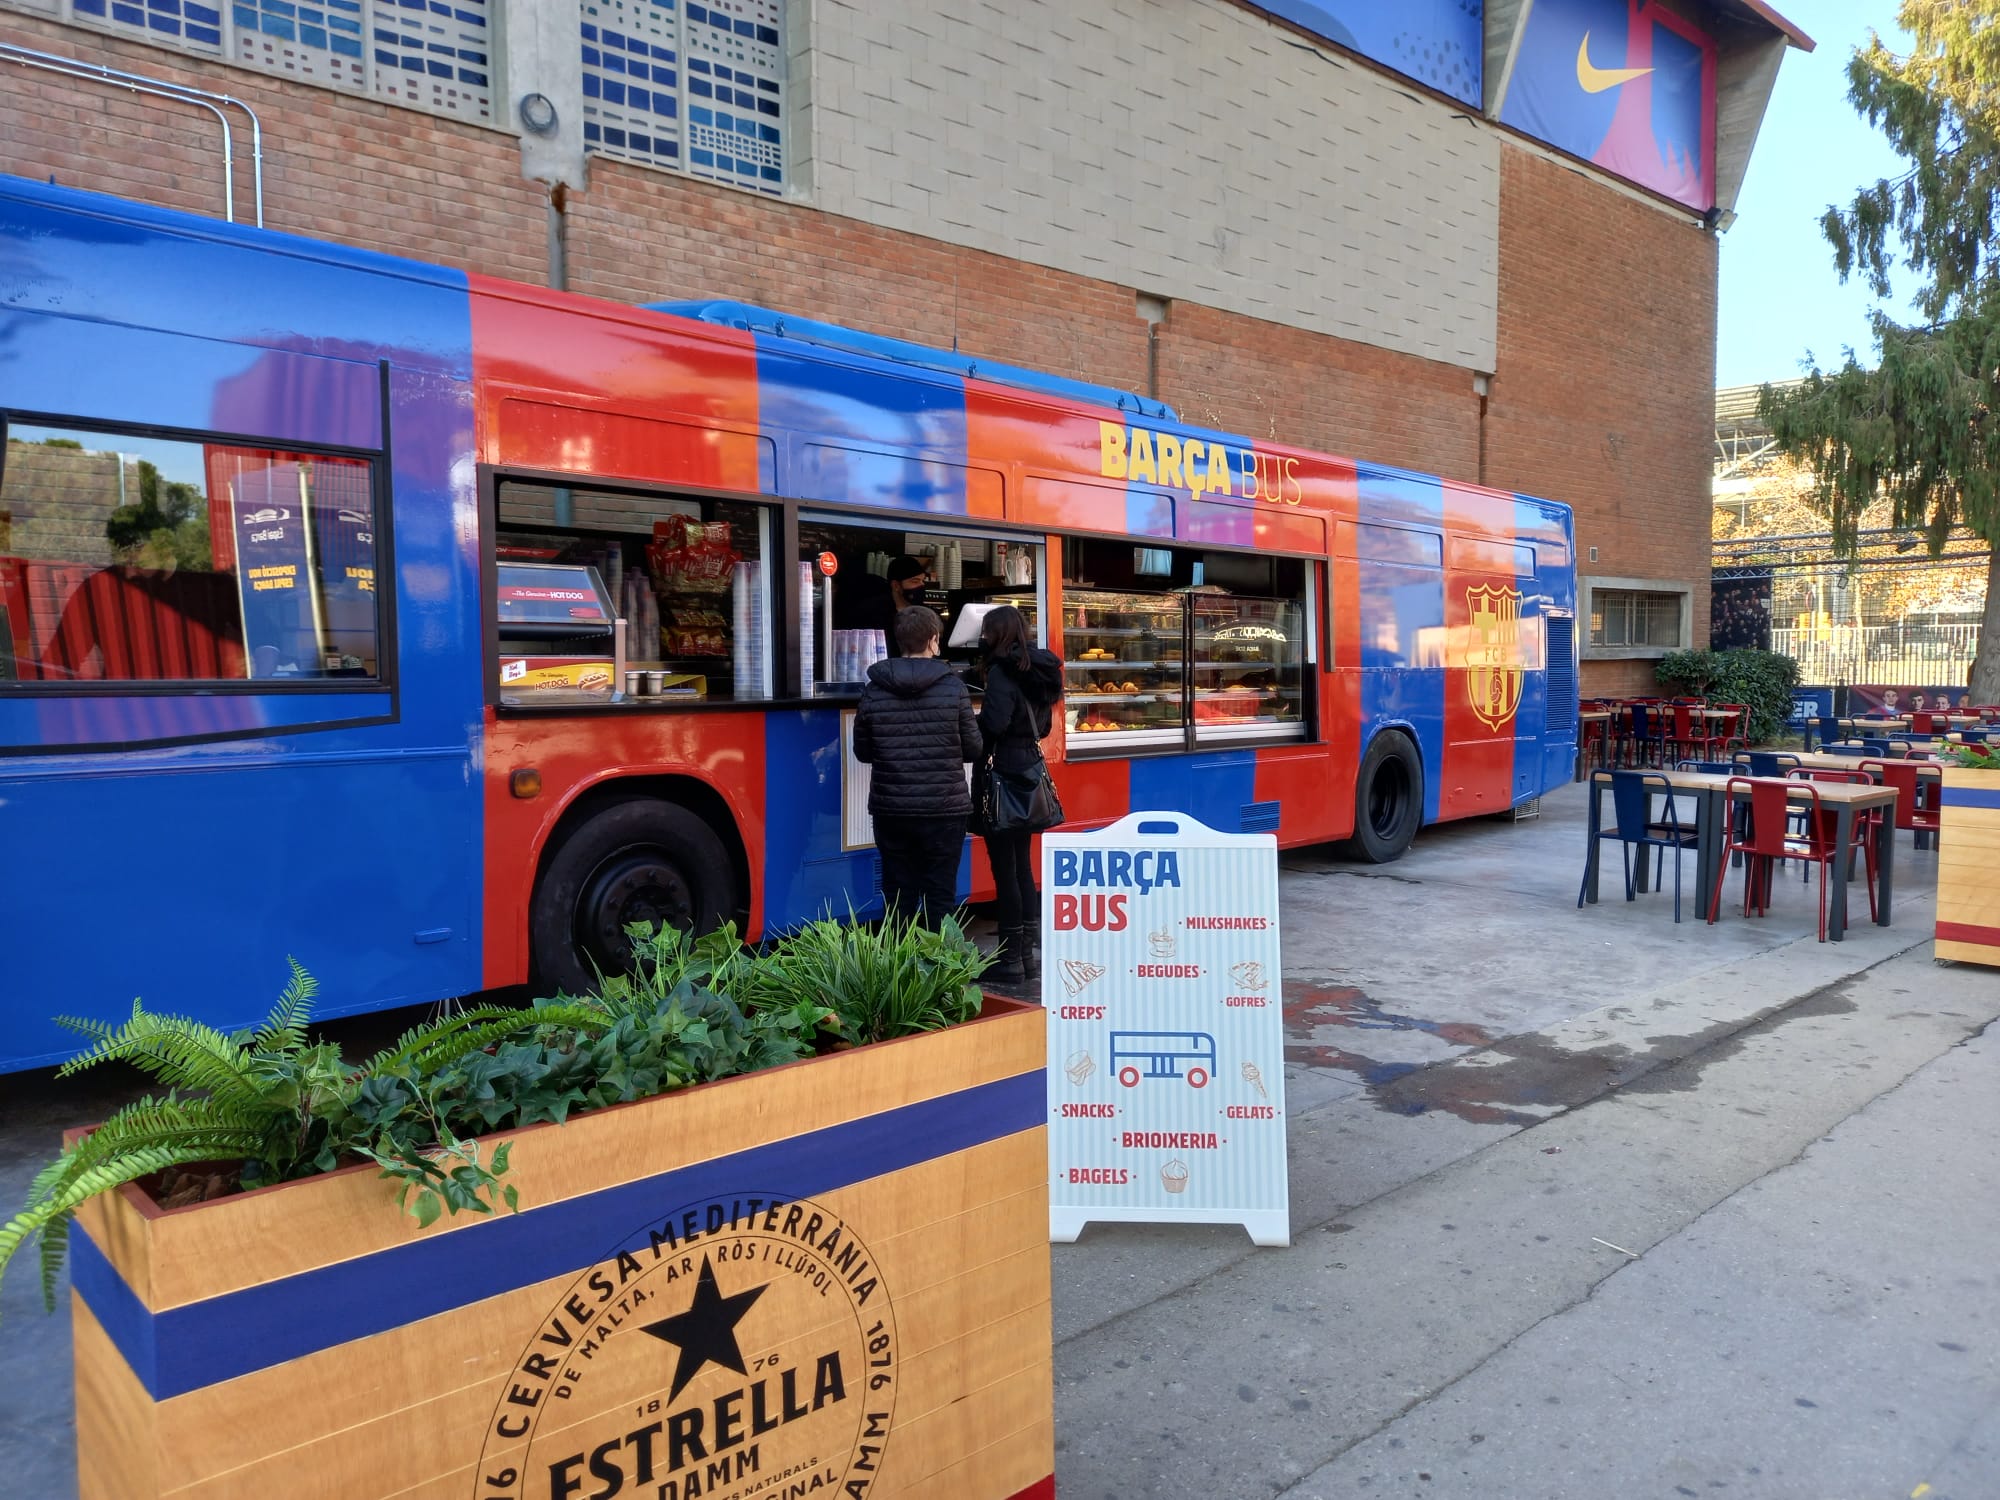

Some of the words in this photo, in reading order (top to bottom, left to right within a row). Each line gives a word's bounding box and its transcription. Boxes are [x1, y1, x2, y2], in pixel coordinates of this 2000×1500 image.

[1099, 420, 1232, 501] BARÇA
[1240, 448, 1302, 506] BUS
[550, 591, 566, 599] HOT
[535, 681, 551, 691] HOT
[551, 678, 569, 688] DOG
[1053, 850, 1181, 896] BARÇA
[1053, 894, 1128, 931] BUS
[1186, 917, 1267, 930] MILKSHAKES
[1137, 964, 1199, 978] BEGUDES
[1060, 1006, 1103, 1020] CREPS
[1226, 996, 1266, 1007] GOFRES
[1061, 1103, 1115, 1118] SNACKS
[1226, 1106, 1274, 1119] GELATS
[1122, 1132, 1218, 1149] BRIOIXERIA
[1069, 1168, 1128, 1185] BAGELS
[648, 1199, 878, 1307] MEDITERRÀNIA
[554, 1367, 582, 1400] DE
[579, 1288, 656, 1360] MALTA,
[763, 1244, 772, 1261] I
[775, 1247, 833, 1297] LLÚPOL
[496, 1249, 644, 1438] CERVESA
[866, 1319, 892, 1391] 1876
[635, 1399, 661, 1418] 18
[753, 1353, 780, 1373] 76
[548, 1350, 847, 1500] ESTRELLA
[657, 1443, 760, 1500] DAMM
[845, 1412, 889, 1500] AMM
[744, 1456, 819, 1497] NATURALS
